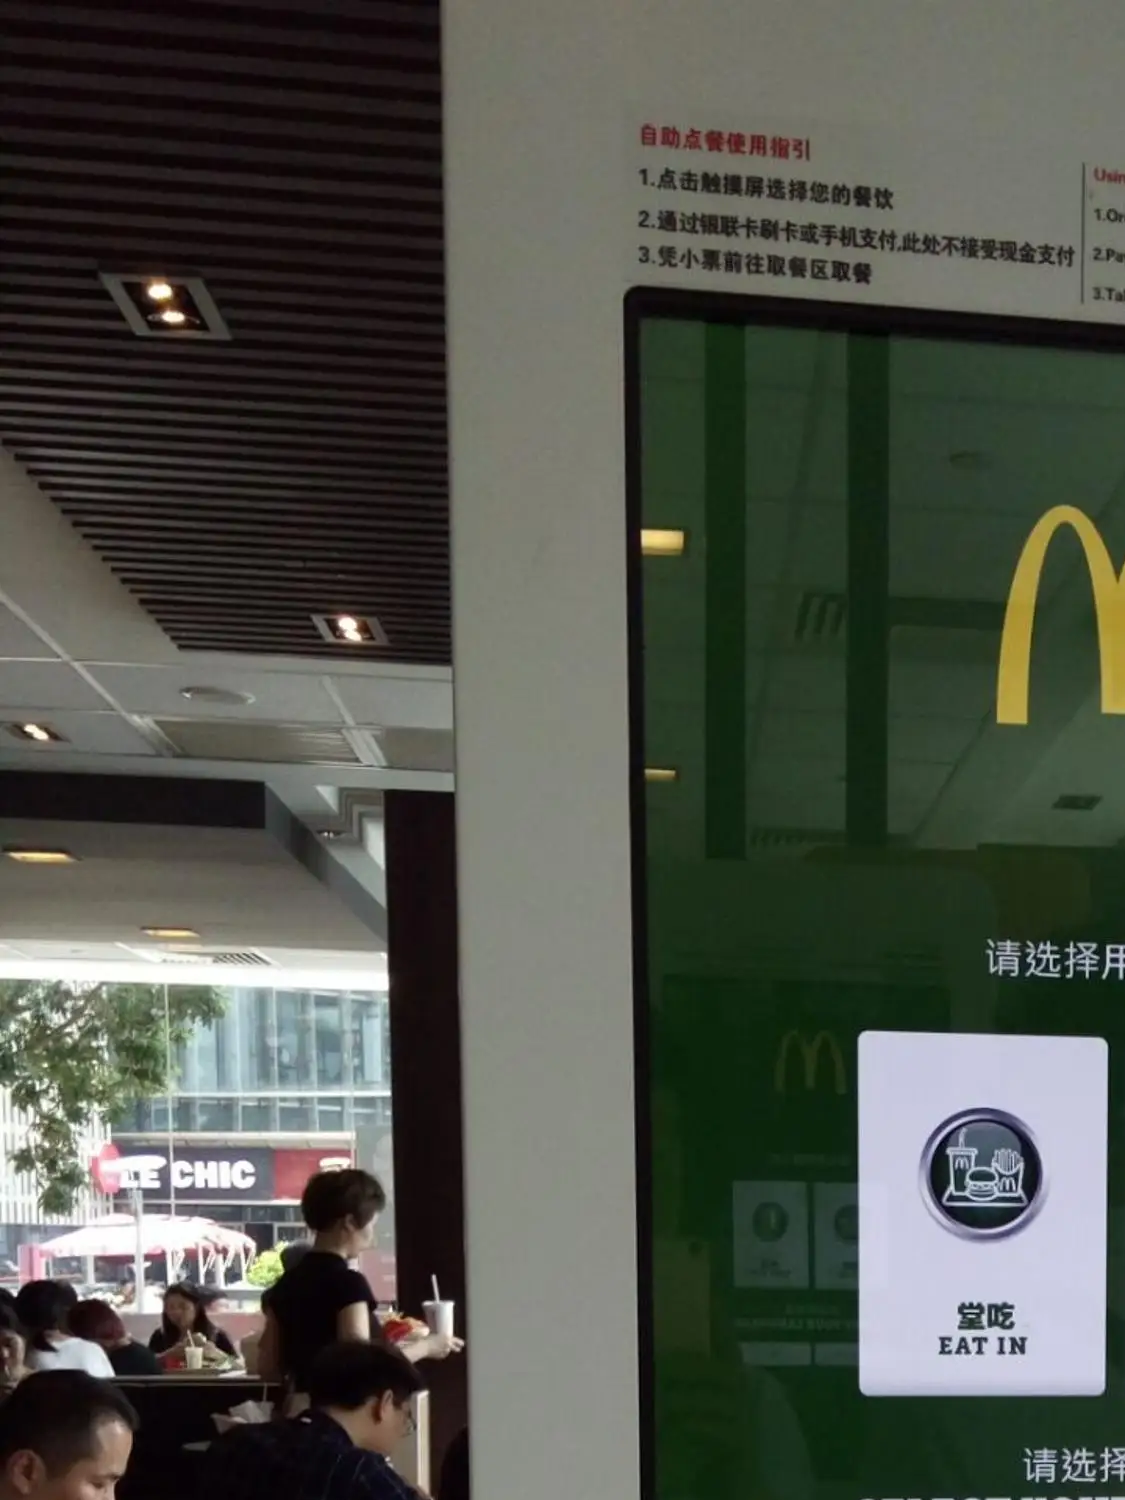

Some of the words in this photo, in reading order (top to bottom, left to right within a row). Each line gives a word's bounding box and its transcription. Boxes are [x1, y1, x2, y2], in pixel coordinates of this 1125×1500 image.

[640, 124, 811, 161] 自助点餐使用指引
[173, 1160, 256, 1189] CHIC
[957, 1302, 1015, 1331] 堂吃
[939, 1337, 987, 1356] EAT
[997, 1337, 1028, 1356] IN
